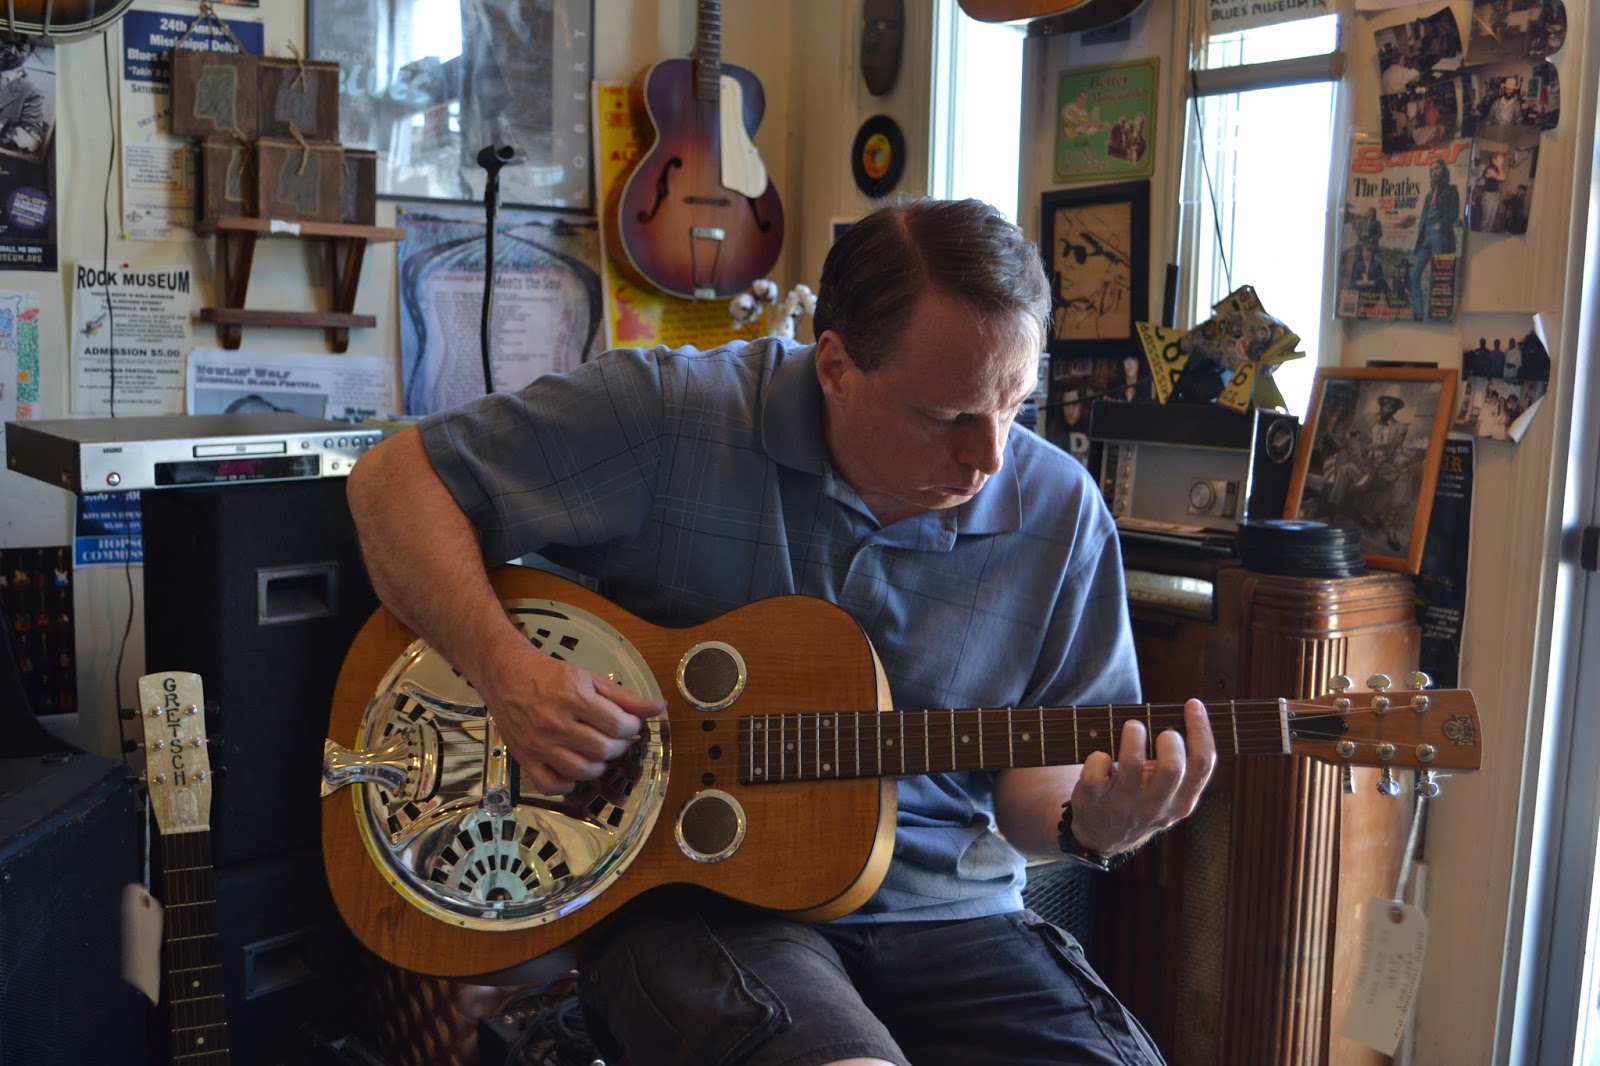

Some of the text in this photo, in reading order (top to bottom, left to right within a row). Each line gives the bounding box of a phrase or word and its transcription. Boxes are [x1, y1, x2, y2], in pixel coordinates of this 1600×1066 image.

[1210, 6, 1248, 21] BLUES
[159, 17, 188, 33] 24th
[127, 47, 158, 61] Blues
[1354, 176, 1421, 197] The Beatles
[77, 265, 190, 295] ROCK MUSEUM
[84, 347, 180, 358] ADMISSION $5.00
[162, 677, 187, 786] GRETSCH
